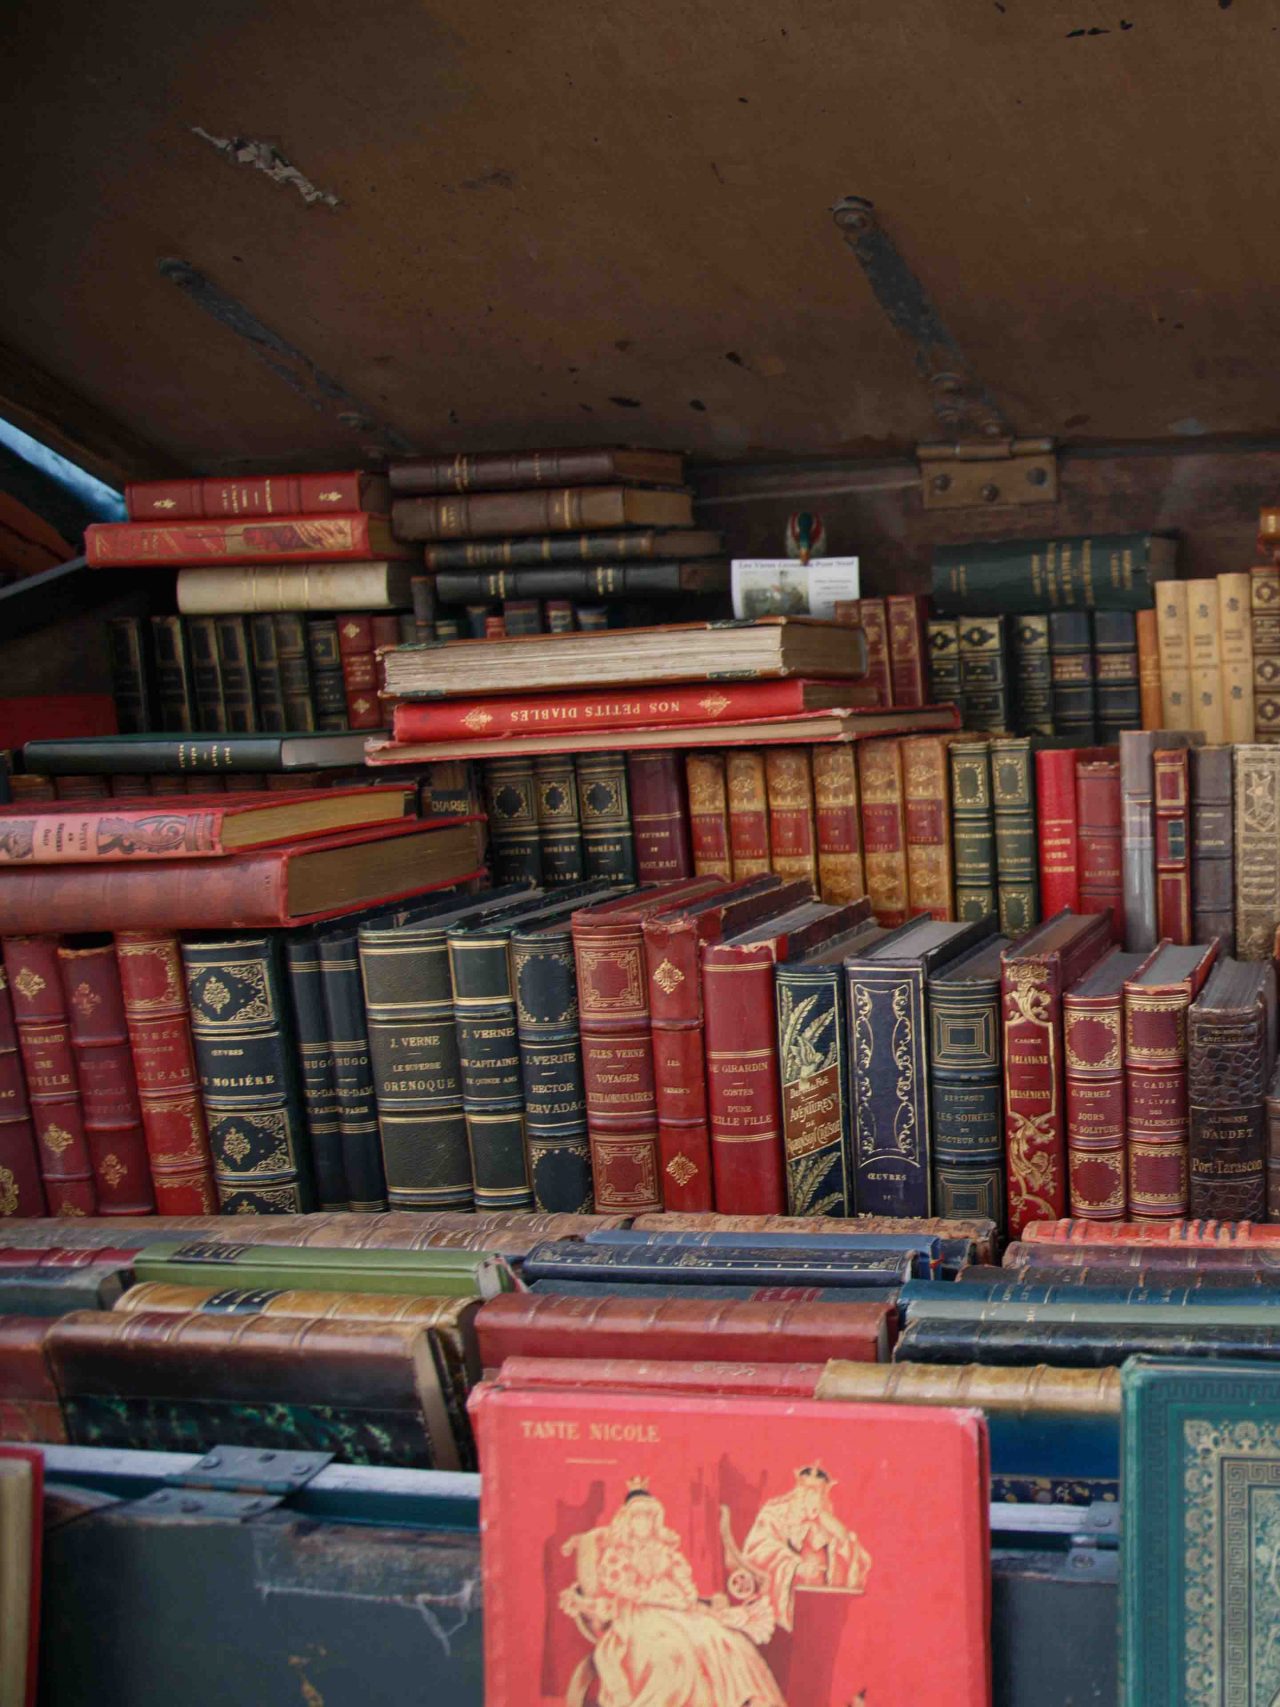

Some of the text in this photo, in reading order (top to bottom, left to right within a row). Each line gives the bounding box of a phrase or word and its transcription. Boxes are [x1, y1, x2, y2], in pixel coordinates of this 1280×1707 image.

[511, 702, 680, 722] NOS PETITS DIABLES
[473, 1027, 515, 1039] VERNE
[401, 1036, 441, 1046] VERNE
[589, 1049, 645, 1058] JULES VERNE
[304, 1059, 334, 1069] HUGO
[336, 1057, 368, 1066] HUGO
[469, 1057, 519, 1068] CAPITAINE
[722, 1062, 768, 1073] GIRARDIN
[596, 1073, 640, 1083] VOYAGES
[384, 1078, 455, 1092] ORENOQUE
[532, 1083, 575, 1094] HECTOR
[1144, 1080, 1181, 1089] CADET
[743, 1115, 773, 1126] FILLE
[936, 1112, 951, 1121] LES
[1078, 1112, 1105, 1121] JOURS
[1079, 1124, 1119, 1134] SOLITUDE
[937, 1135, 974, 1144] DOCTEUR
[1192, 1159, 1263, 1174] Port-Tarascon
[867, 1173, 907, 1181] ŒUVRES
[521, 1420, 661, 1443] TANTE NICOLE
